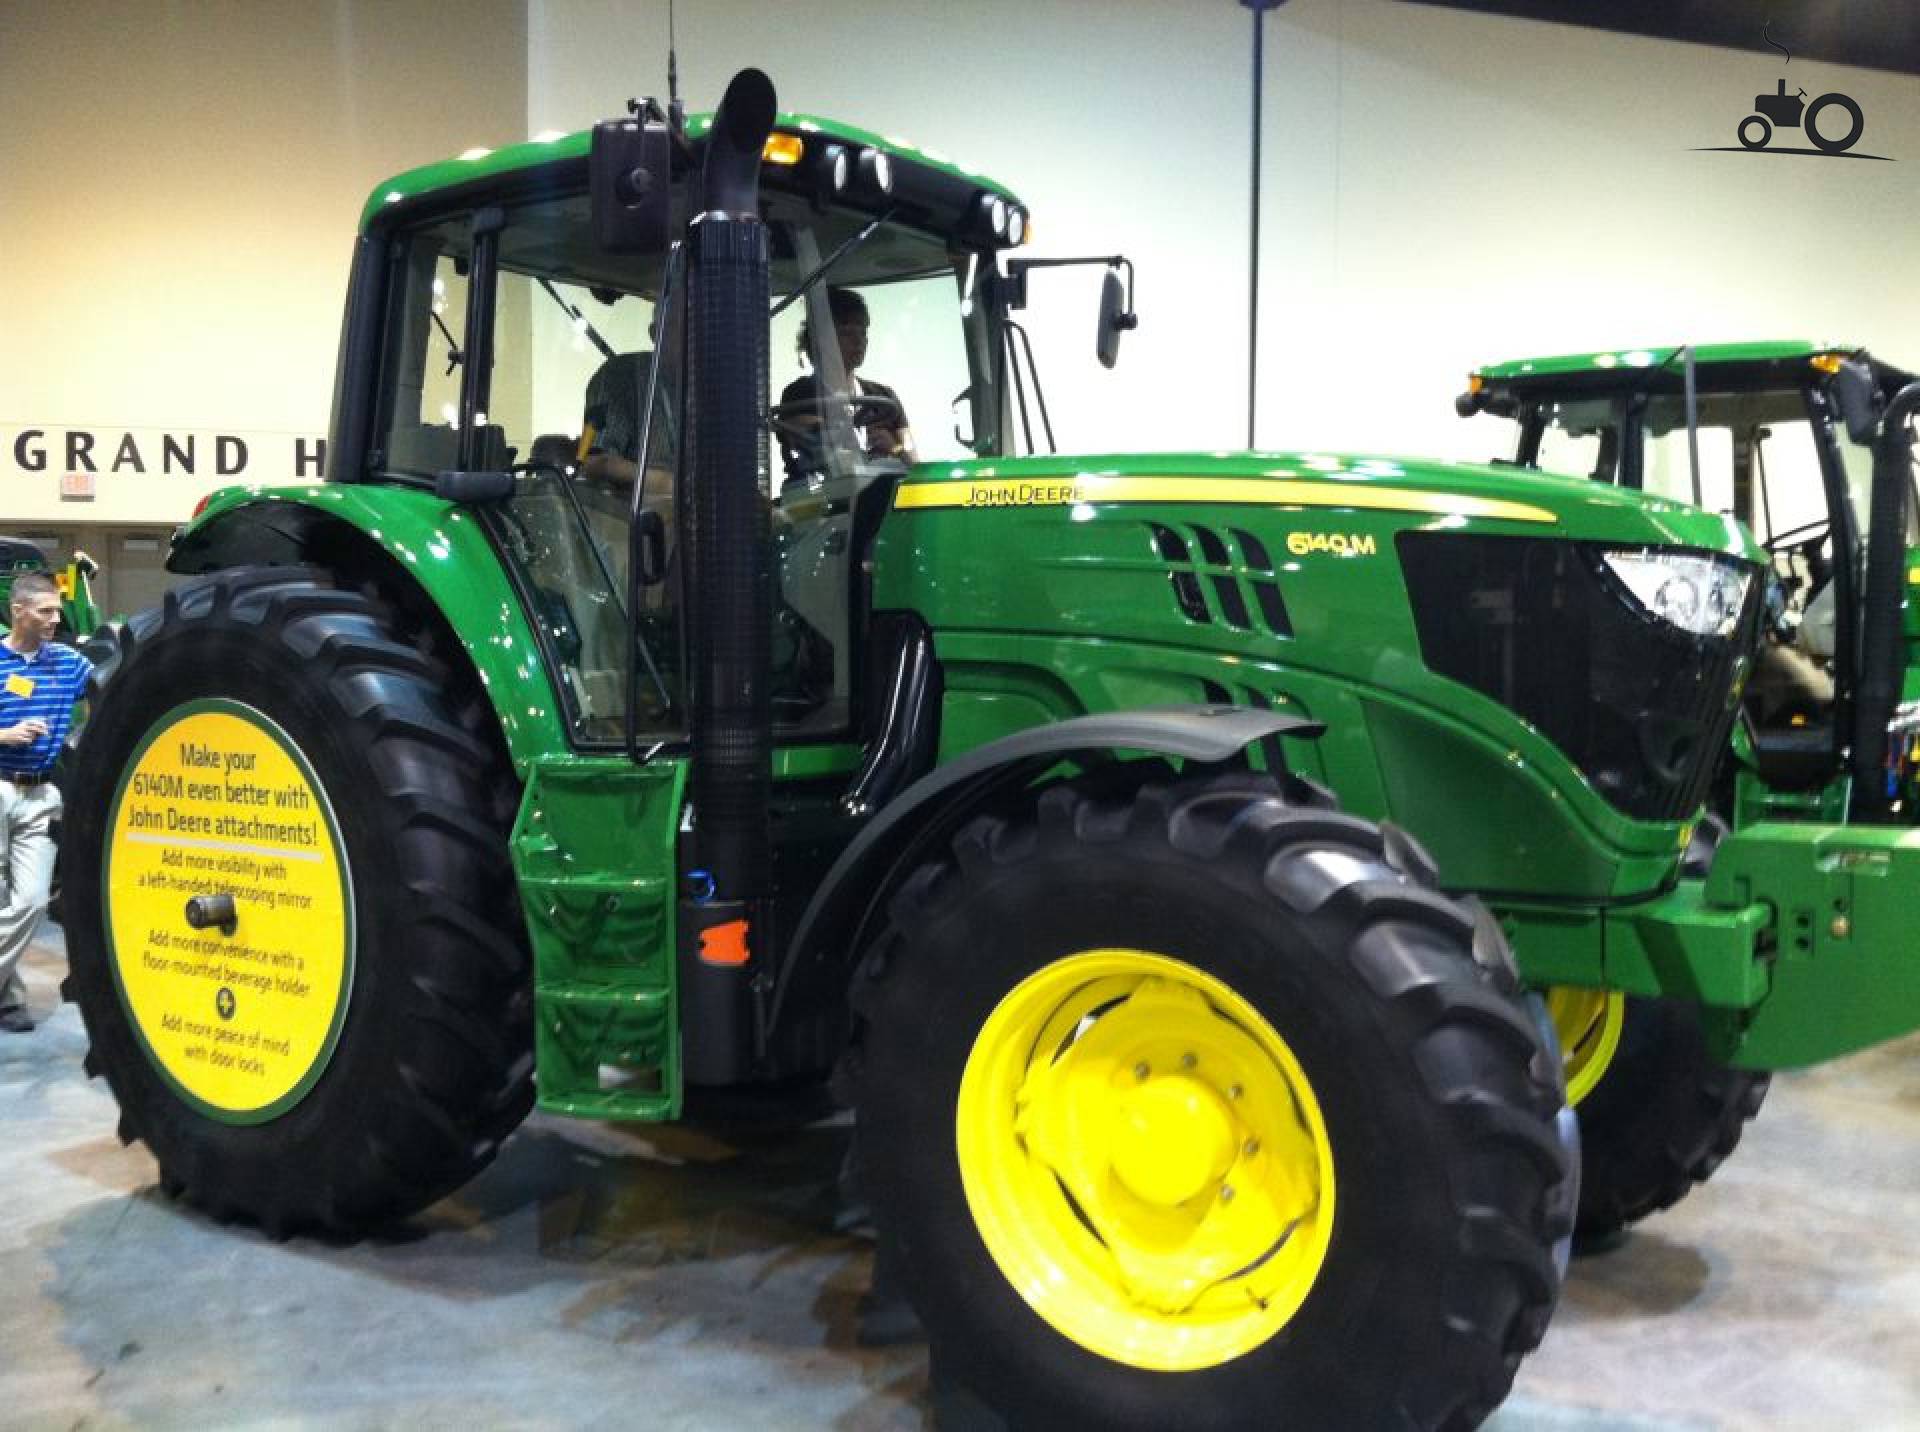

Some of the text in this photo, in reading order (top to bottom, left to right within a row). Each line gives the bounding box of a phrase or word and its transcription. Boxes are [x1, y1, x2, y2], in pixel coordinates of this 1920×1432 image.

[14, 429, 249, 475] GRAND
[1287, 531, 1376, 556] 6140M
[180, 743, 257, 776] Make your
[134, 772, 309, 809] 6140M even better with
[128, 803, 317, 847] John Deere attachments!
[162, 849, 287, 881] Add more visibility with
[138, 874, 145, 887] a
[148, 870, 213, 895] left-handed
[277, 892, 312, 908] mirror
[148, 929, 305, 971] Add more convenience with a
[223, 965, 273, 994] beverage
[275, 974, 311, 998] holder
[161, 1013, 291, 1057] Add more peace of mind
[184, 1046, 208, 1060] with
